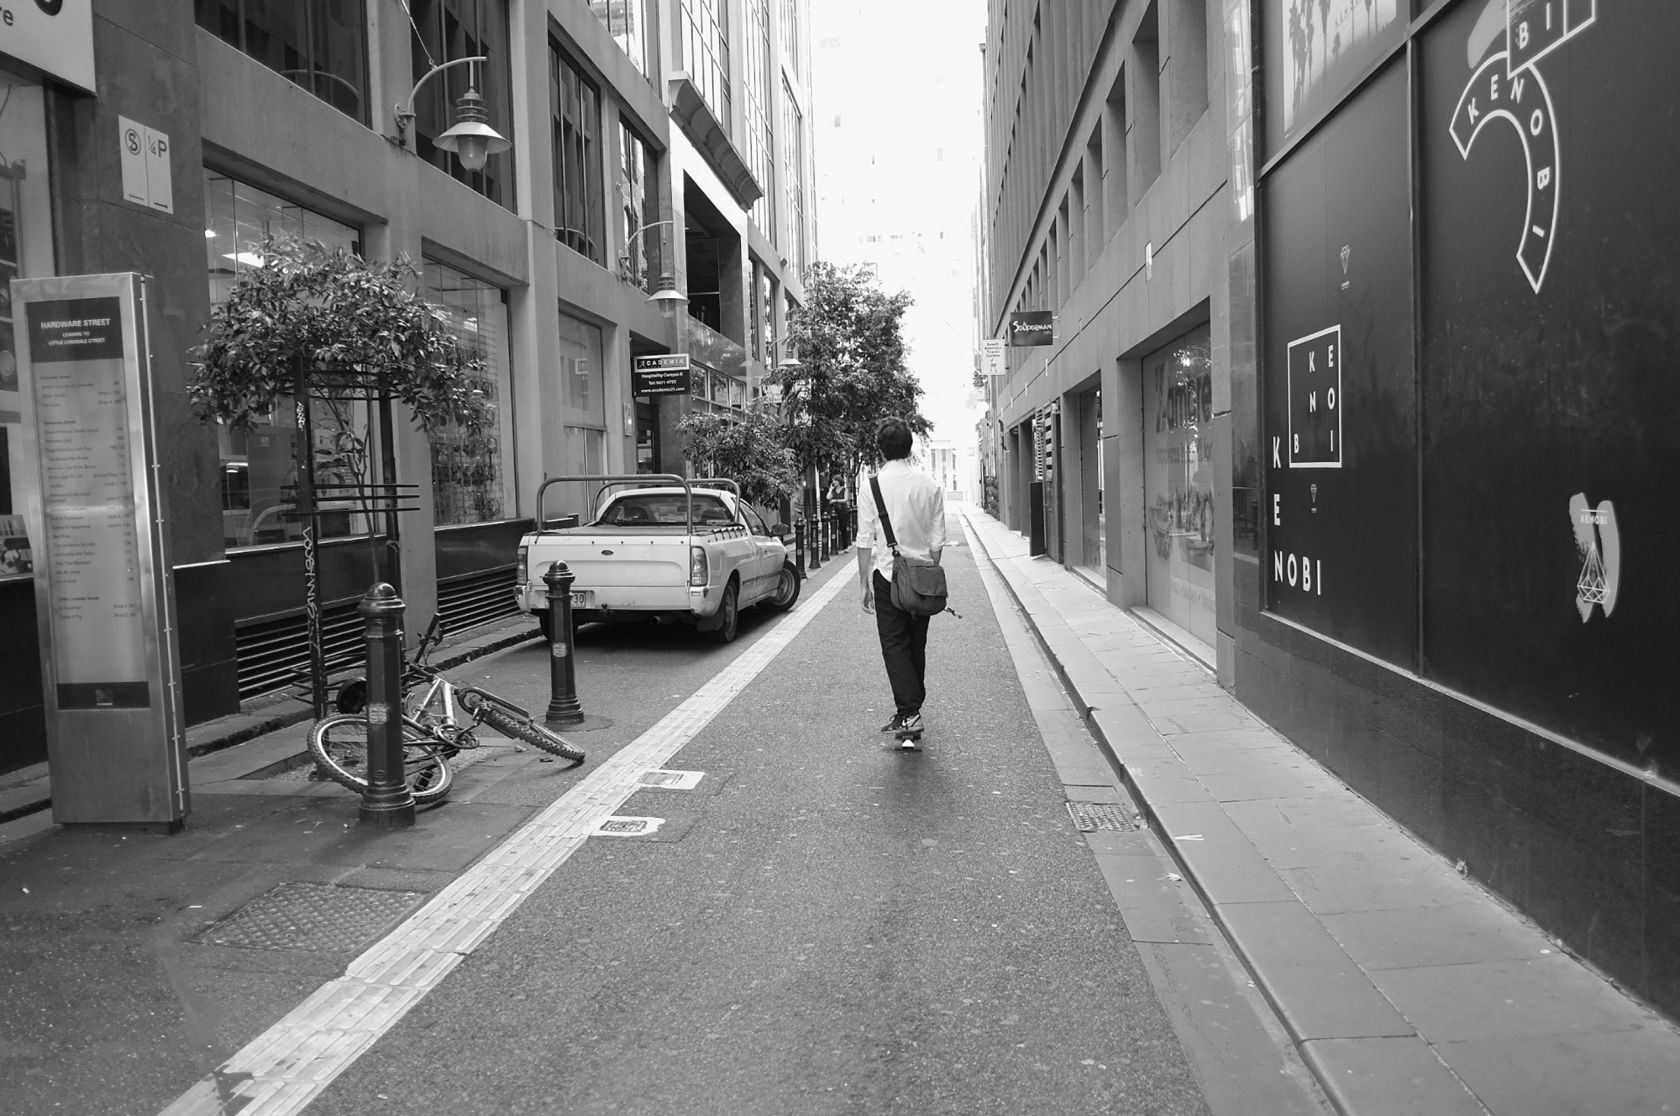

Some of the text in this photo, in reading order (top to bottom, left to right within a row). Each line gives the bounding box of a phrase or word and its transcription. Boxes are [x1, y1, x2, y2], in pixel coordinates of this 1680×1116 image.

[1467, 74, 1550, 238] KENOBI
[40, 318, 110, 329] HARDWARE STREET
